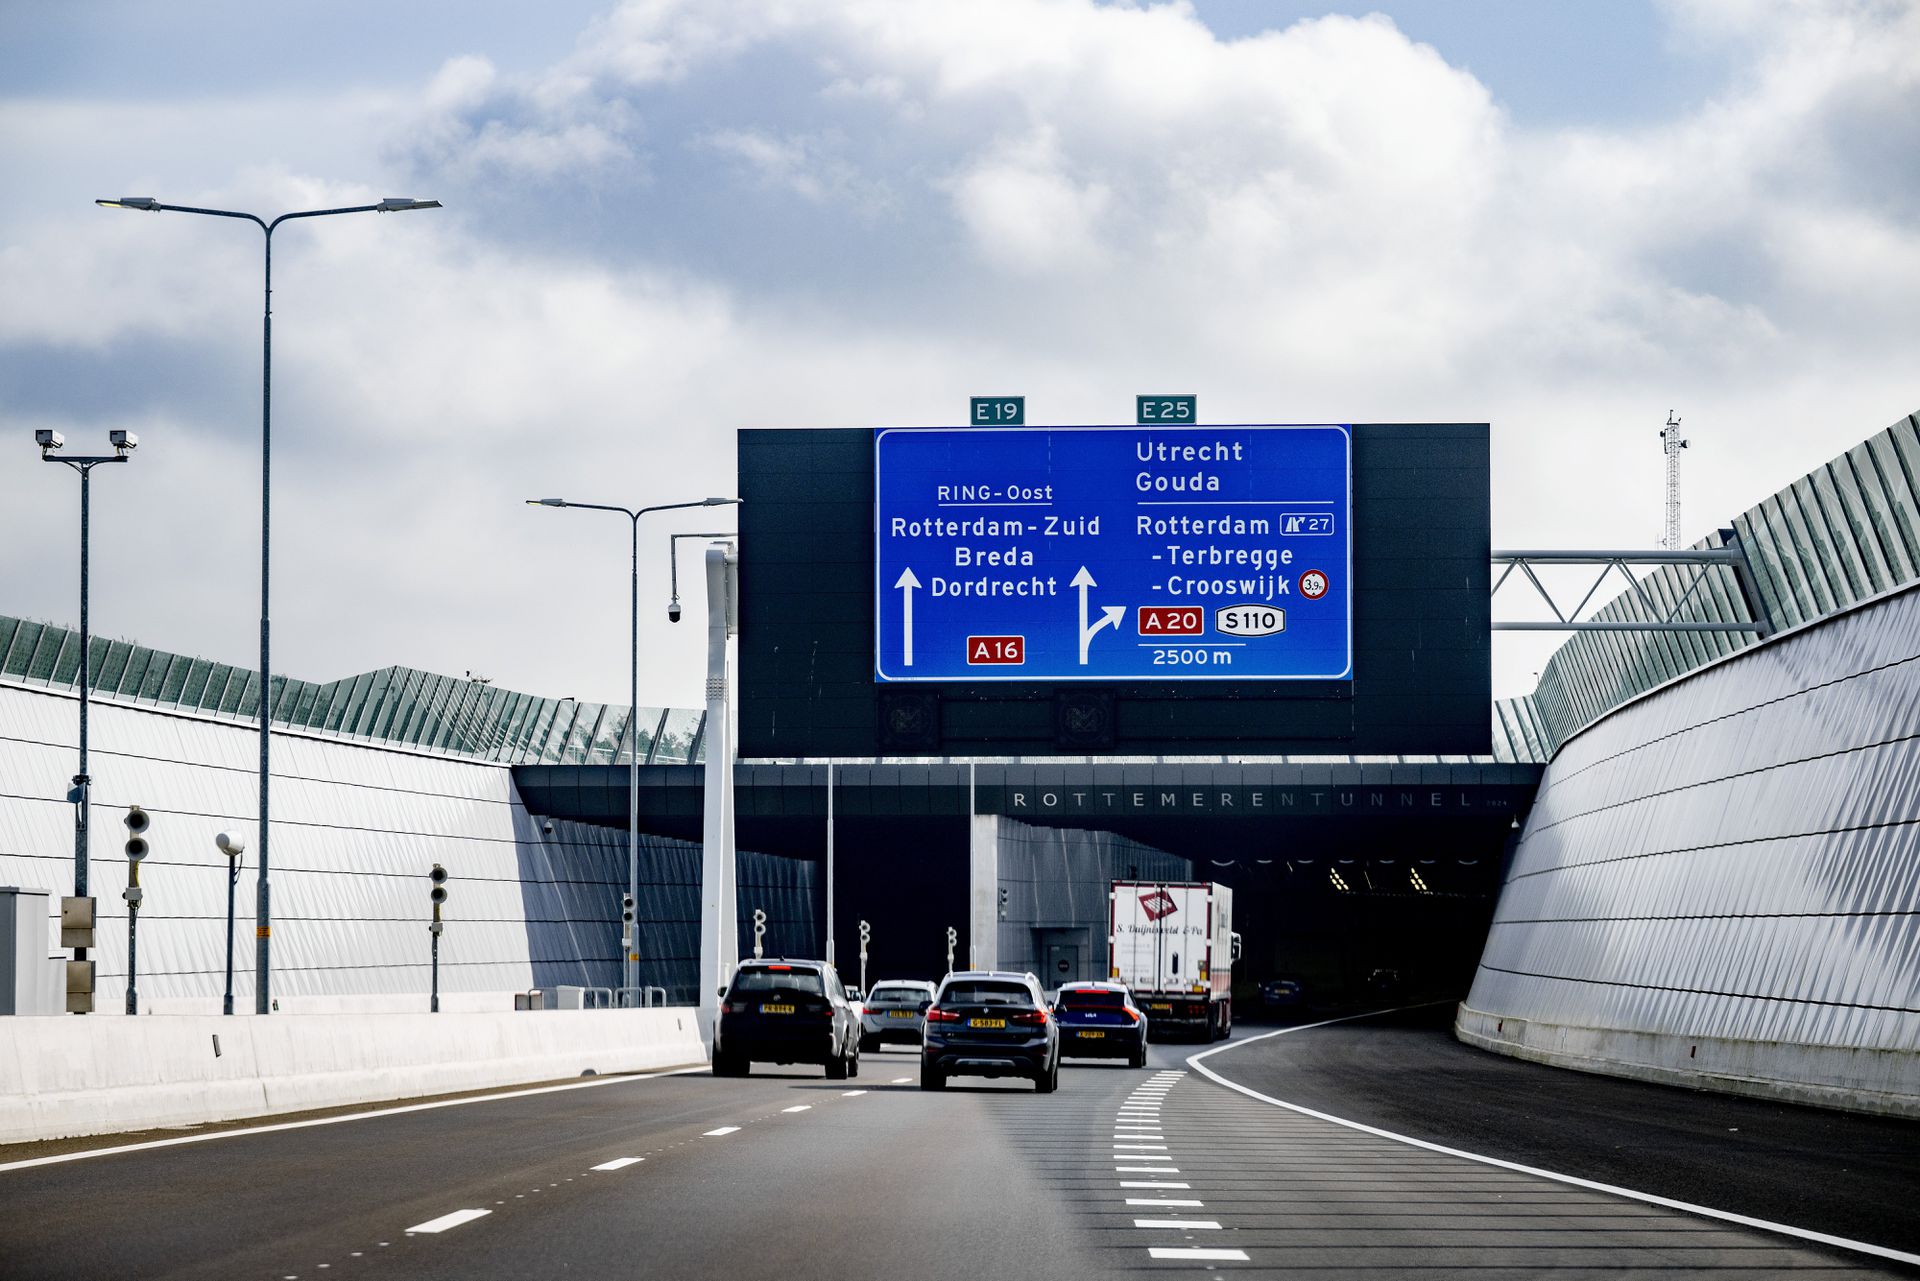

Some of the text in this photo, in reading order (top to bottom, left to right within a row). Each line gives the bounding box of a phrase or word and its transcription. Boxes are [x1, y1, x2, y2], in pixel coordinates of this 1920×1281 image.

[1136, 442, 1243, 462] Utrecht
[1136, 472, 1220, 492] Gouda
[938, 485, 1053, 501] RING-Oost
[892, 516, 1100, 537] Rotterdam-Zuid
[1137, 515, 1269, 536] Rotterdam
[1308, 519, 1329, 531] 27
[955, 547, 1034, 567] Breda
[932, 577, 1057, 597] Dordrecht
[1153, 650, 1232, 665] 2500 m
